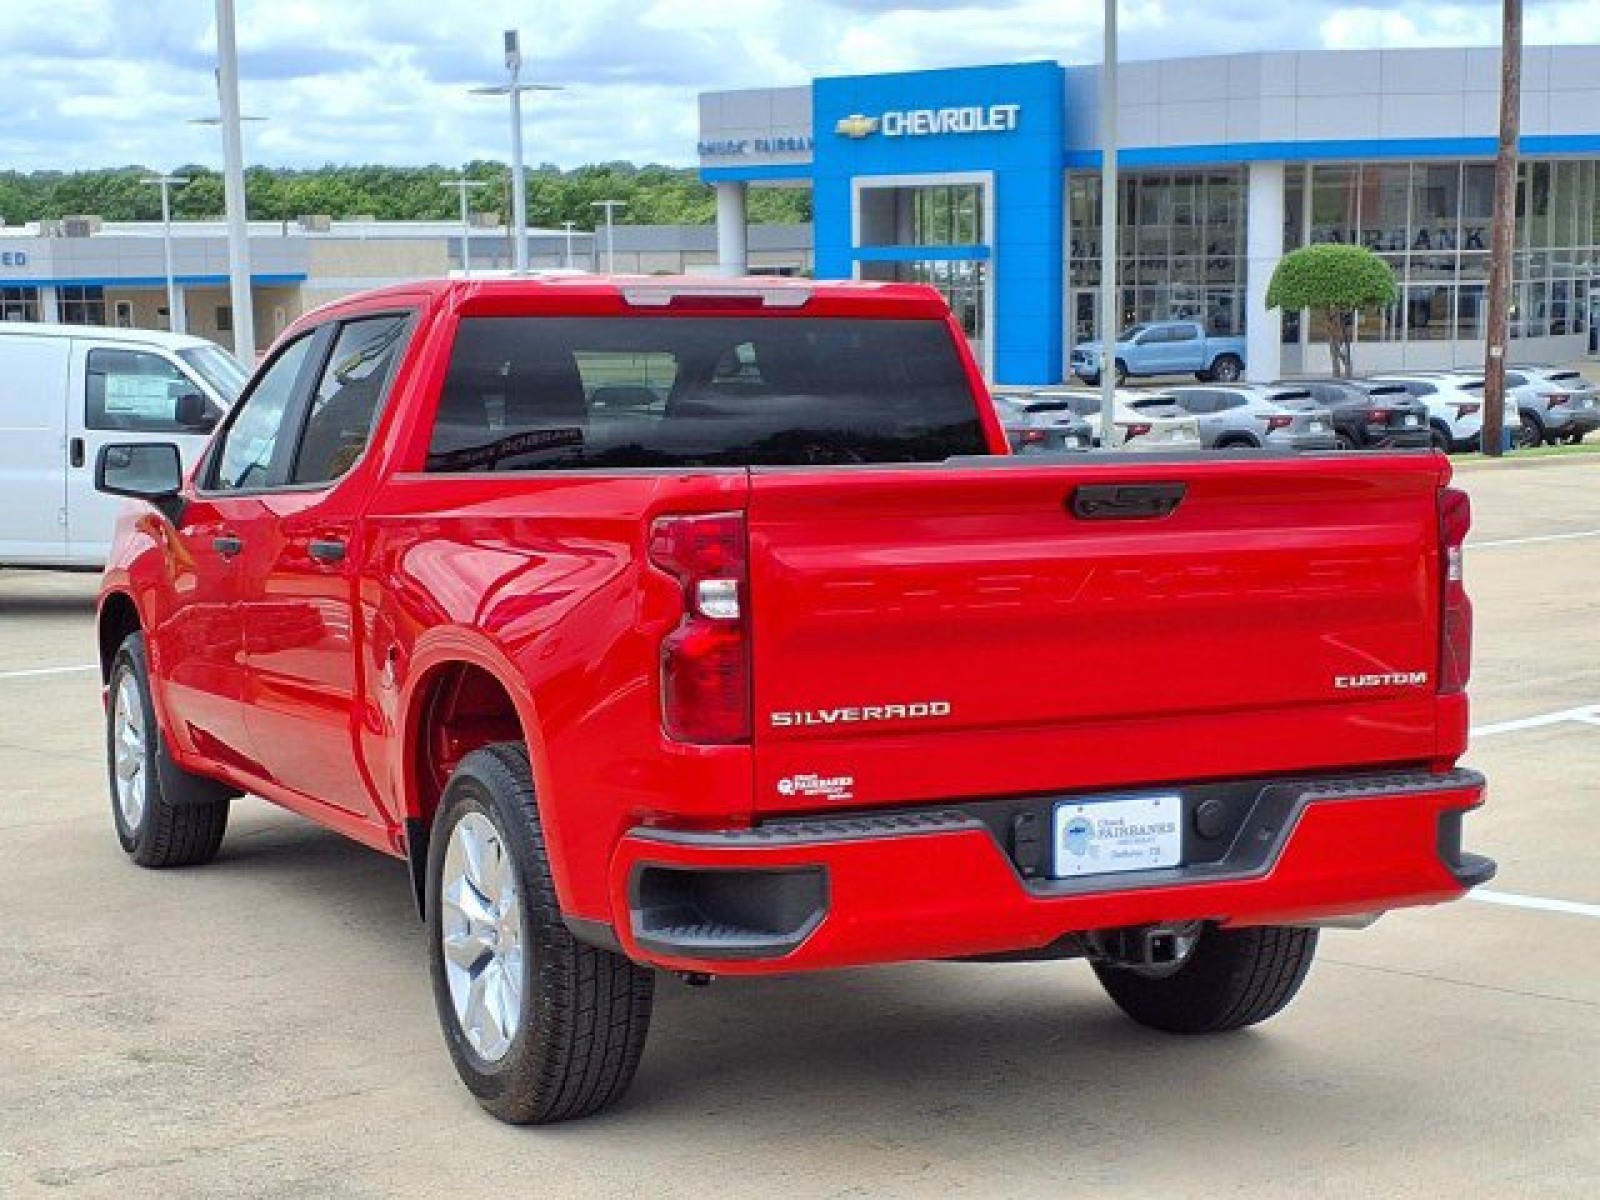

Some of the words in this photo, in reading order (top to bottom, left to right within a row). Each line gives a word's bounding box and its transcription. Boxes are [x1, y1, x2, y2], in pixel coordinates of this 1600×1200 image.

[882, 105, 1020, 136] CHEVROLET
[1334, 671, 1428, 689] CUSTOM
[770, 700, 951, 727] SILVERADO
